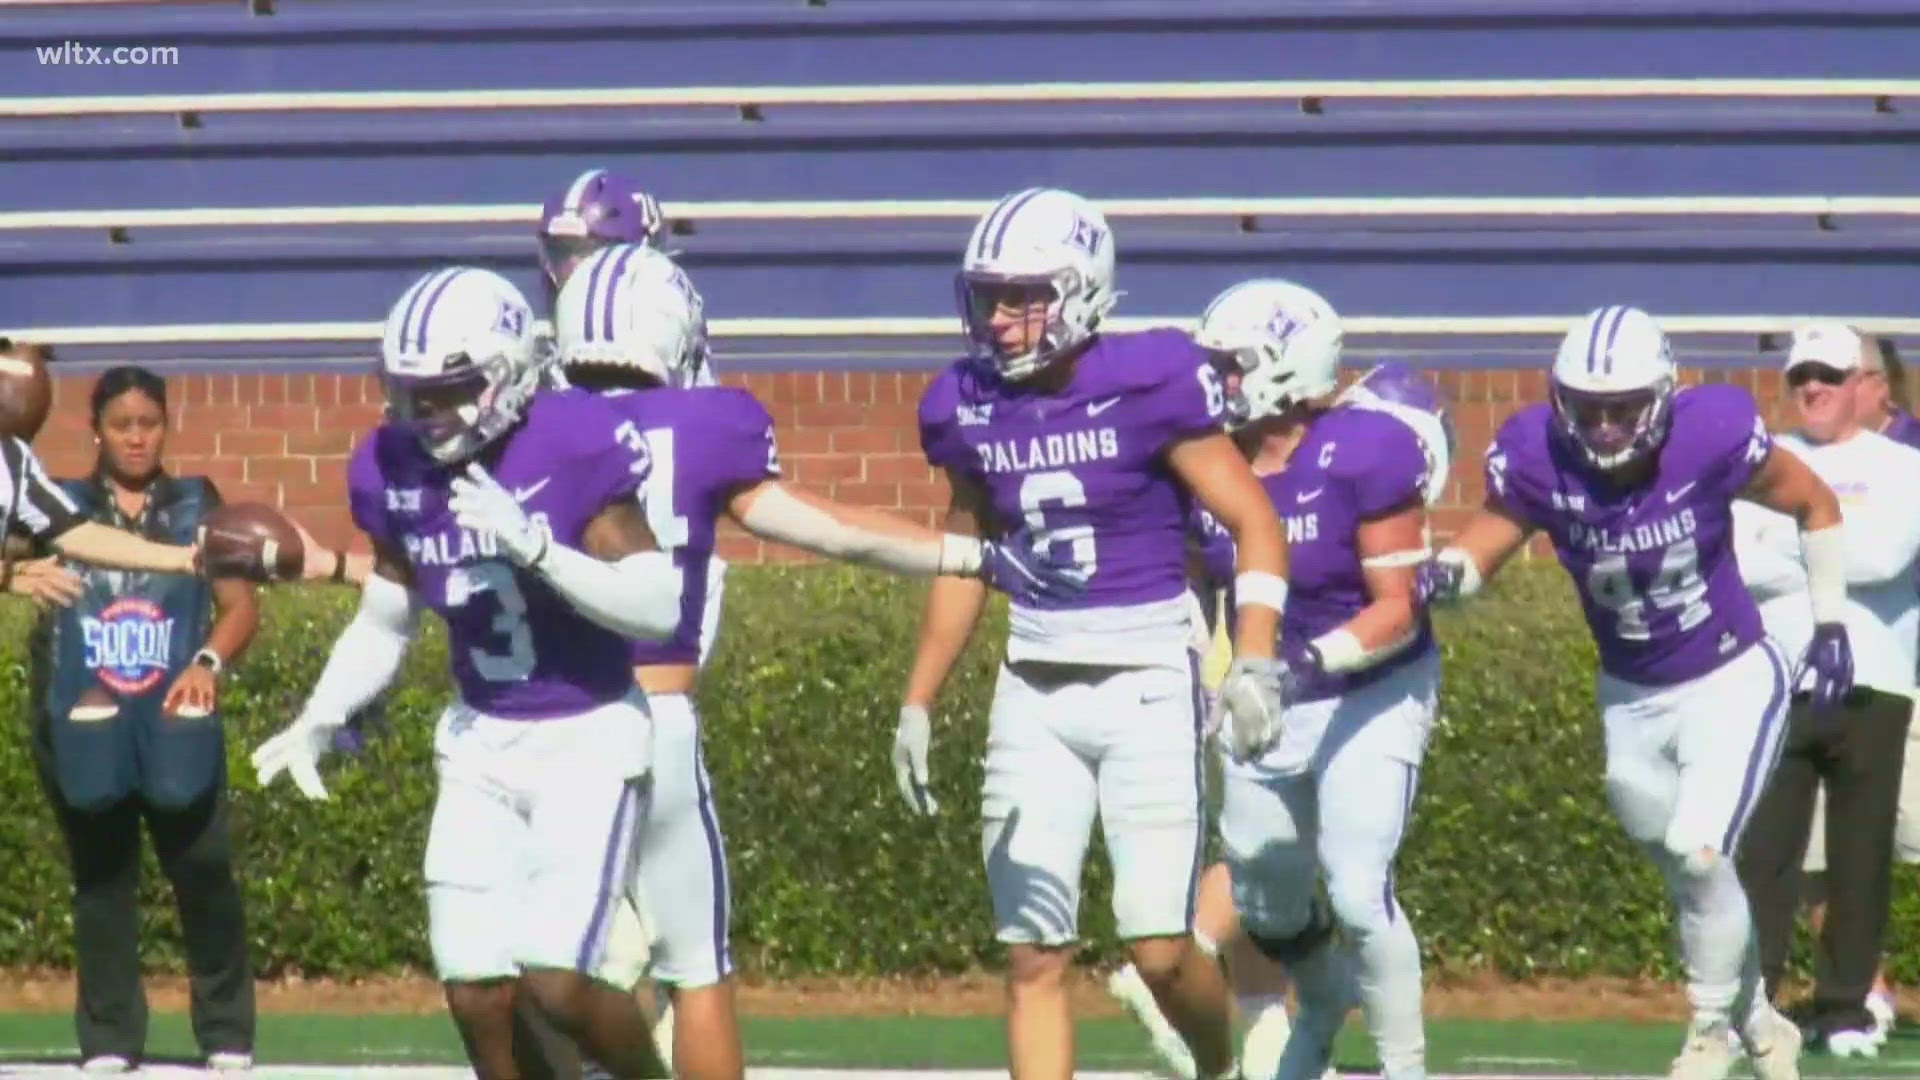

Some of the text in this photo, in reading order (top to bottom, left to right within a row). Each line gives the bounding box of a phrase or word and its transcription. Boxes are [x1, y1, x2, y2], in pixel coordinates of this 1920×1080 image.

[977, 427, 1118, 473] PALADINS
[1318, 441, 1337, 468] C
[1020, 470, 1098, 583] 6
[1568, 507, 1697, 553] PALADINS
[1586, 537, 1712, 641] 44
[80, 616, 174, 670] SOCON
[445, 560, 538, 682] 3
